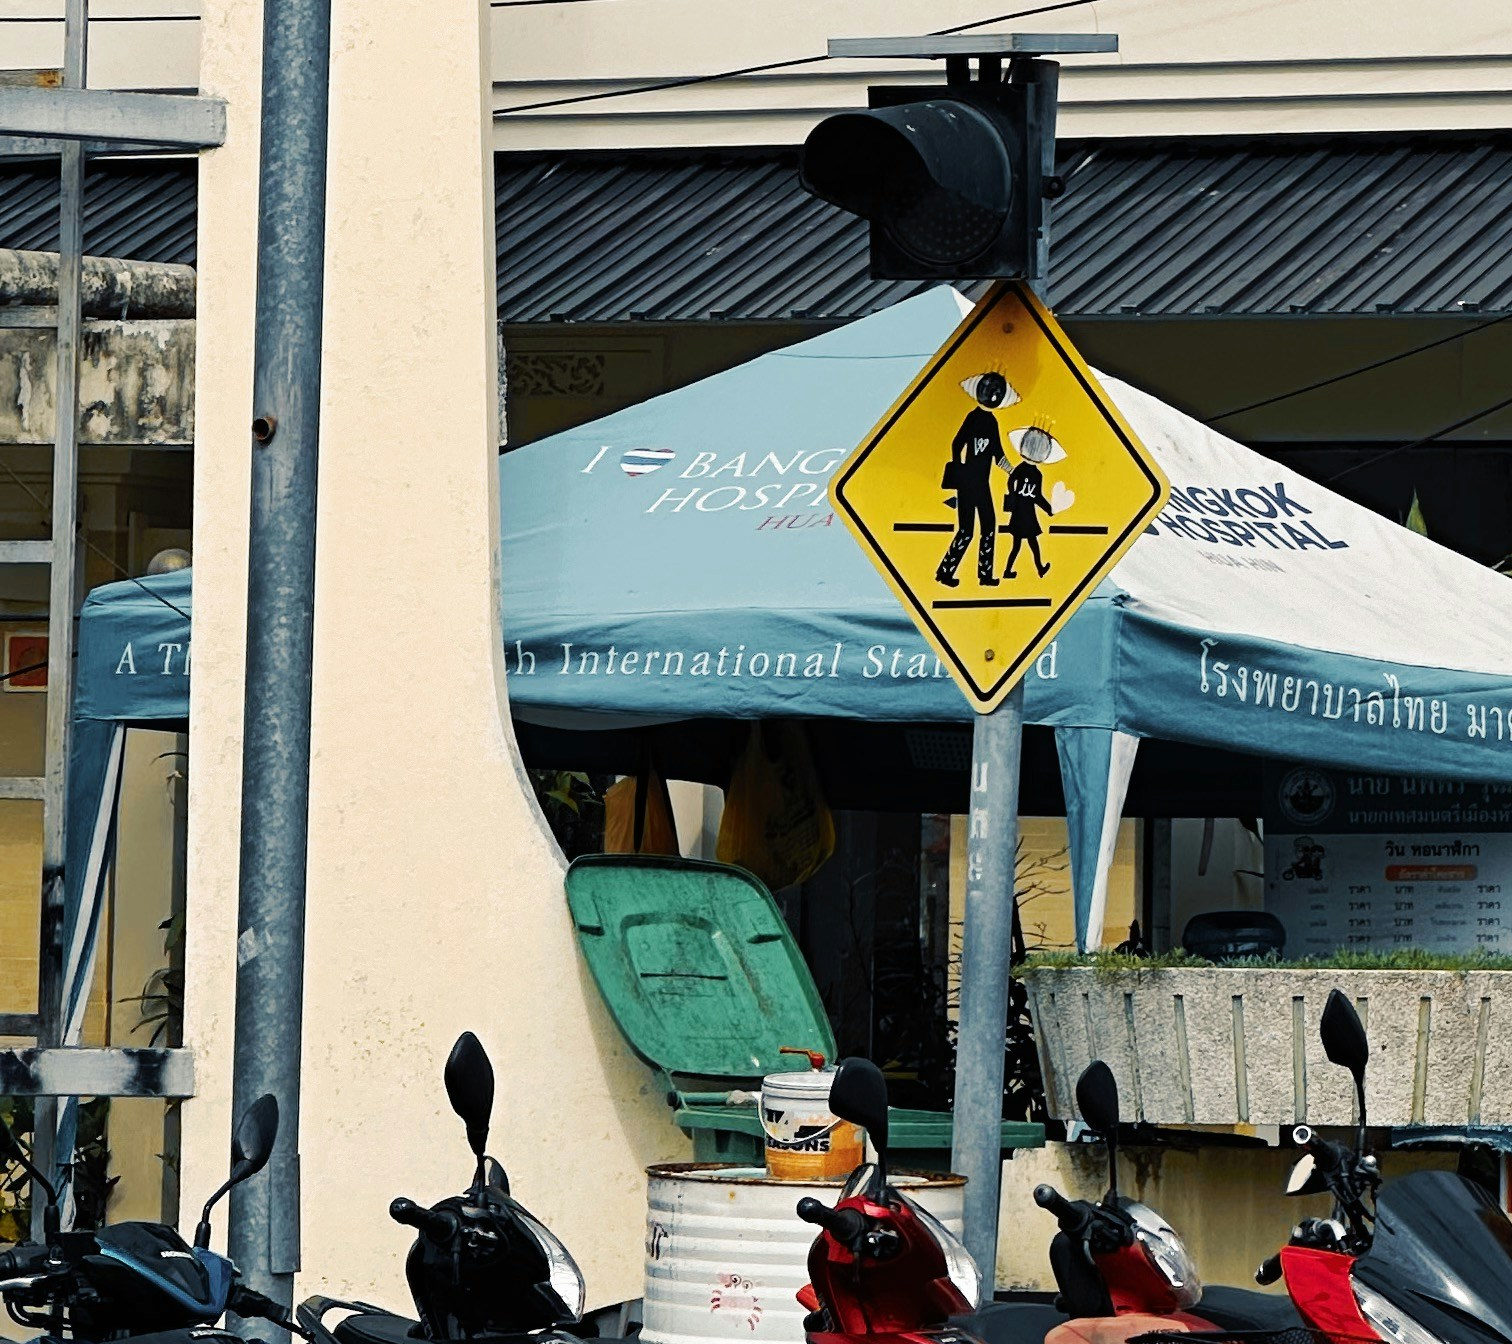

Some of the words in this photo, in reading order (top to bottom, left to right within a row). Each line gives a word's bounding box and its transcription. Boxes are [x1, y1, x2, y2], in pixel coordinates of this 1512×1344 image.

[678, 448, 847, 479] BANG
[644, 483, 829, 514] HOSPI
[1166, 481, 1313, 519] NGKOK
[1156, 512, 1350, 550] HOSPITAL
[115, 641, 137, 675] A
[559, 642, 843, 678] International
[1200, 637, 1448, 734] โรงพยาบาลไทย
